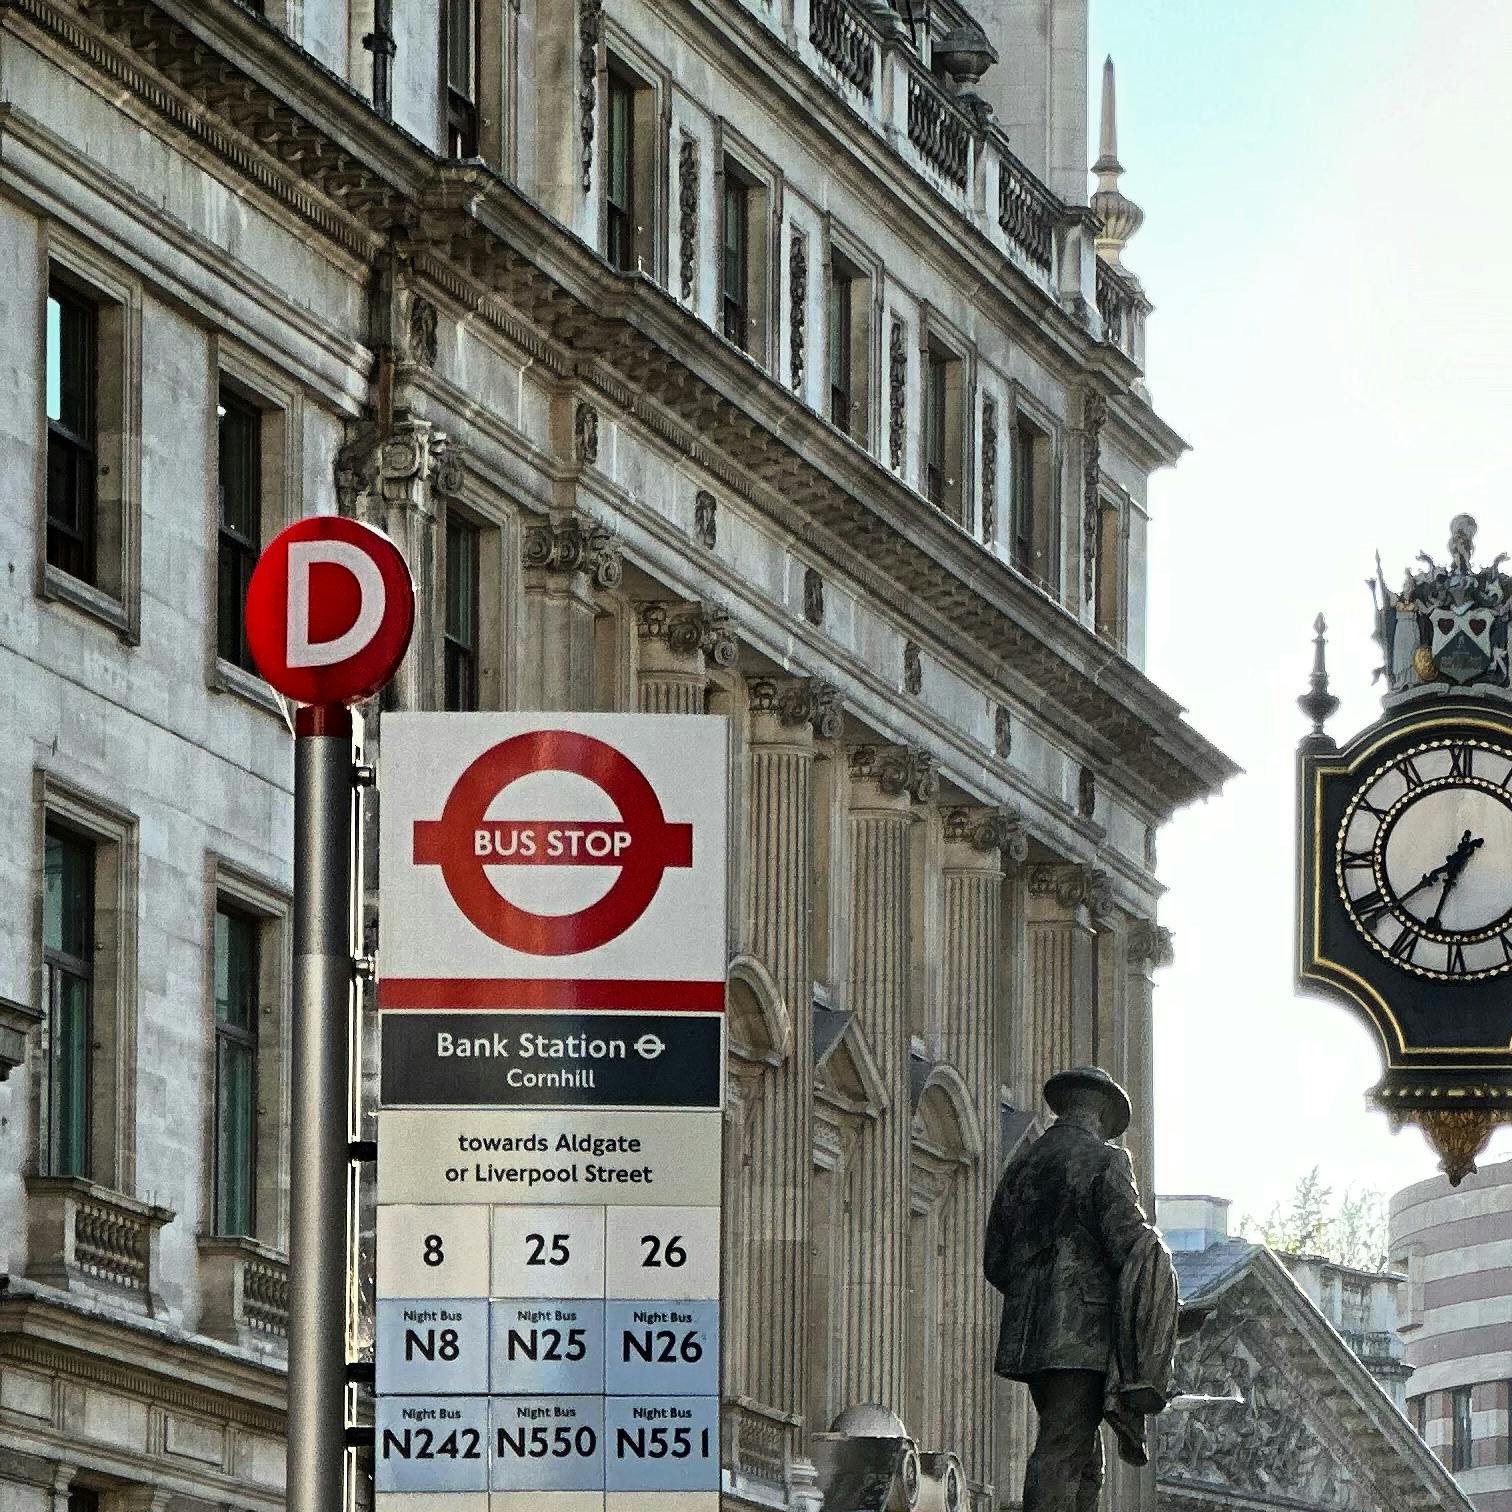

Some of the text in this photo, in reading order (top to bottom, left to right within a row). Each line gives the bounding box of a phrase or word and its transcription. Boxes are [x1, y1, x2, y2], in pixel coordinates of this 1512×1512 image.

[288, 540, 385, 668] D
[474, 830, 632, 858] BUS STOP
[437, 1033, 626, 1060] Bank Station
[507, 1069, 595, 1089] Cornhill
[459, 1133, 641, 1156] towards Aldgate
[446, 1164, 652, 1186] or Liverpool Street
[424, 1235, 444, 1267] 8
[526, 1234, 570, 1266] 25
[641, 1235, 687, 1267] 26
[404, 1311, 462, 1324] Night Bus
[517, 1311, 577, 1324] Night Bus
[633, 1312, 692, 1325] Night Bus
[405, 1329, 460, 1362] N8
[508, 1329, 587, 1361] N25
[623, 1330, 703, 1363] N26
[403, 1409, 461, 1421] Night Bus
[517, 1407, 576, 1420] Night Bus
[633, 1408, 692, 1420] Night Bus
[383, 1429, 481, 1460] N242
[497, 1426, 597, 1458] N550
[617, 1428, 710, 1460] N551
